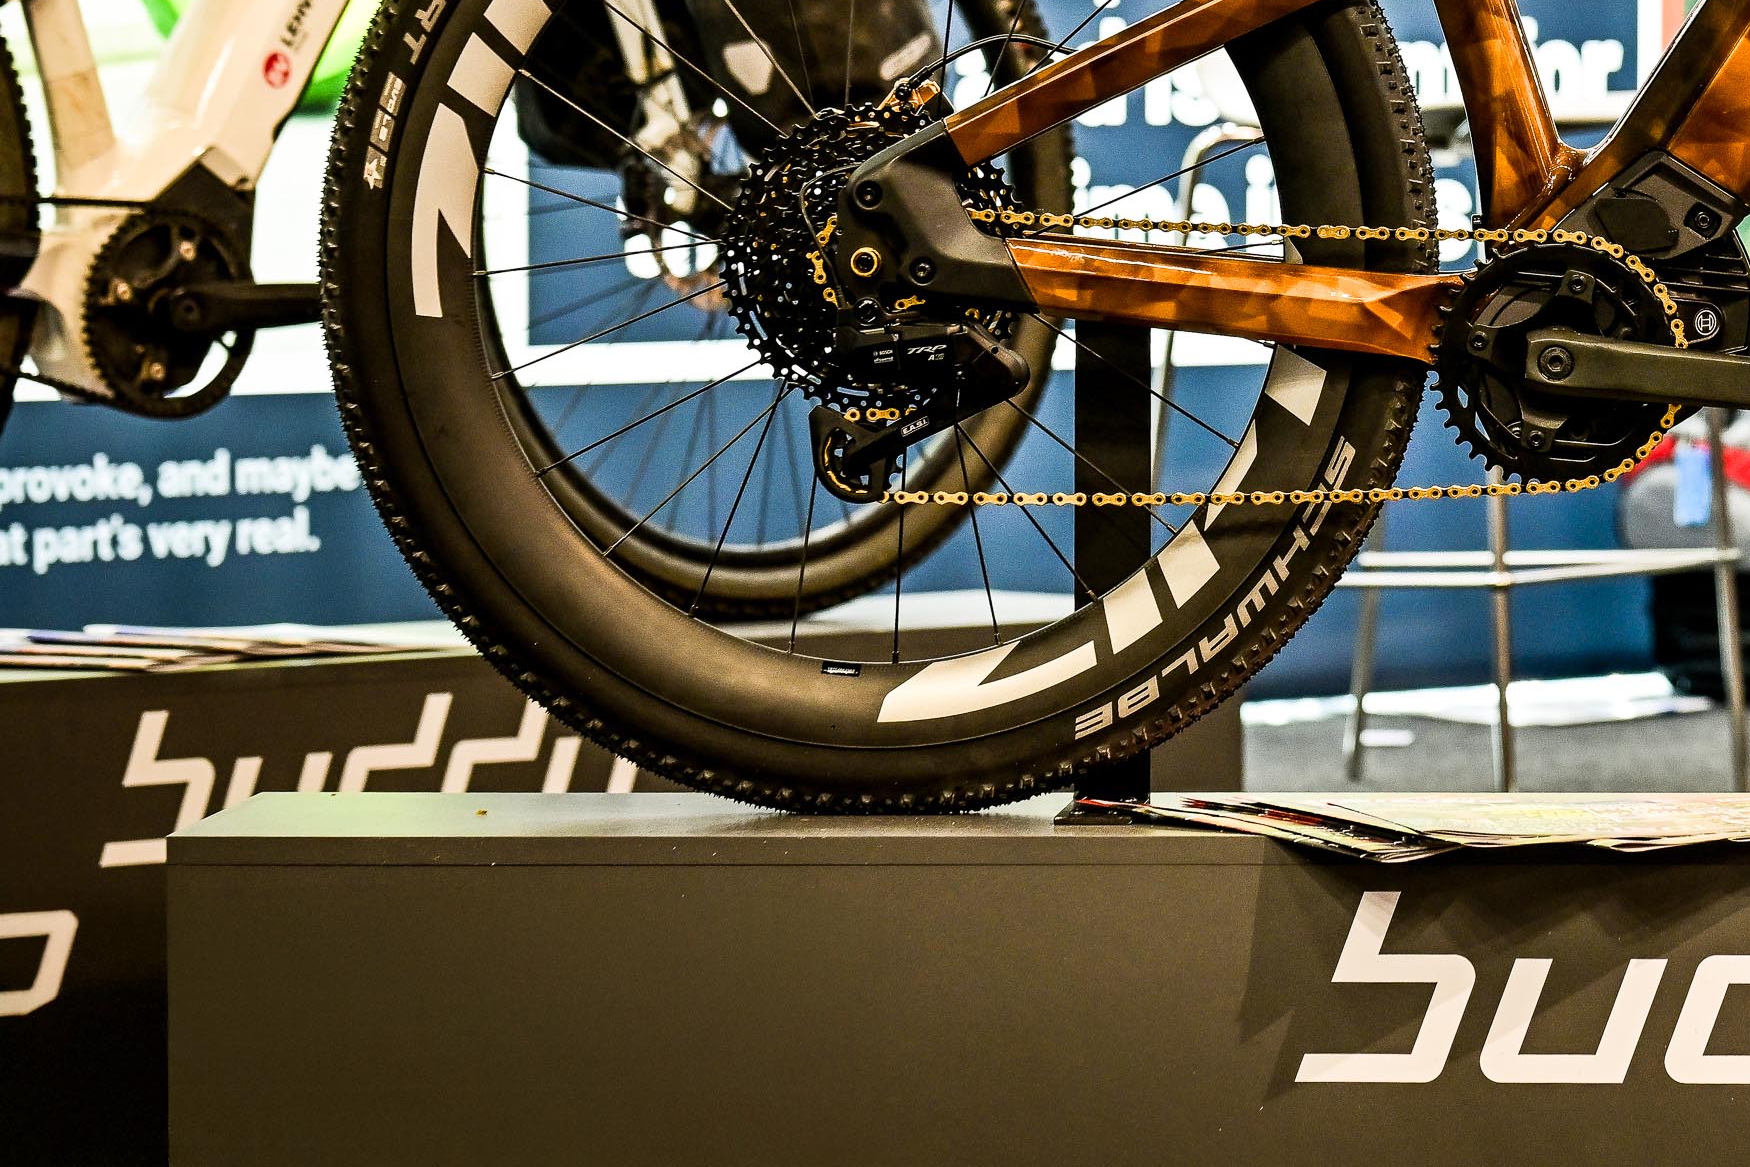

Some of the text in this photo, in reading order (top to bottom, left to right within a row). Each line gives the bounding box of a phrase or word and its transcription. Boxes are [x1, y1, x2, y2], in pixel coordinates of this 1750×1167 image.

[907, 344, 947, 355] TRP
[157, 447, 231, 498] and
[235, 443, 363, 503] maybe
[33, 512, 144, 575] part's
[147, 519, 232, 567] very
[235, 504, 322, 555] real.
[1074, 436, 1354, 740] SCHWALBE
